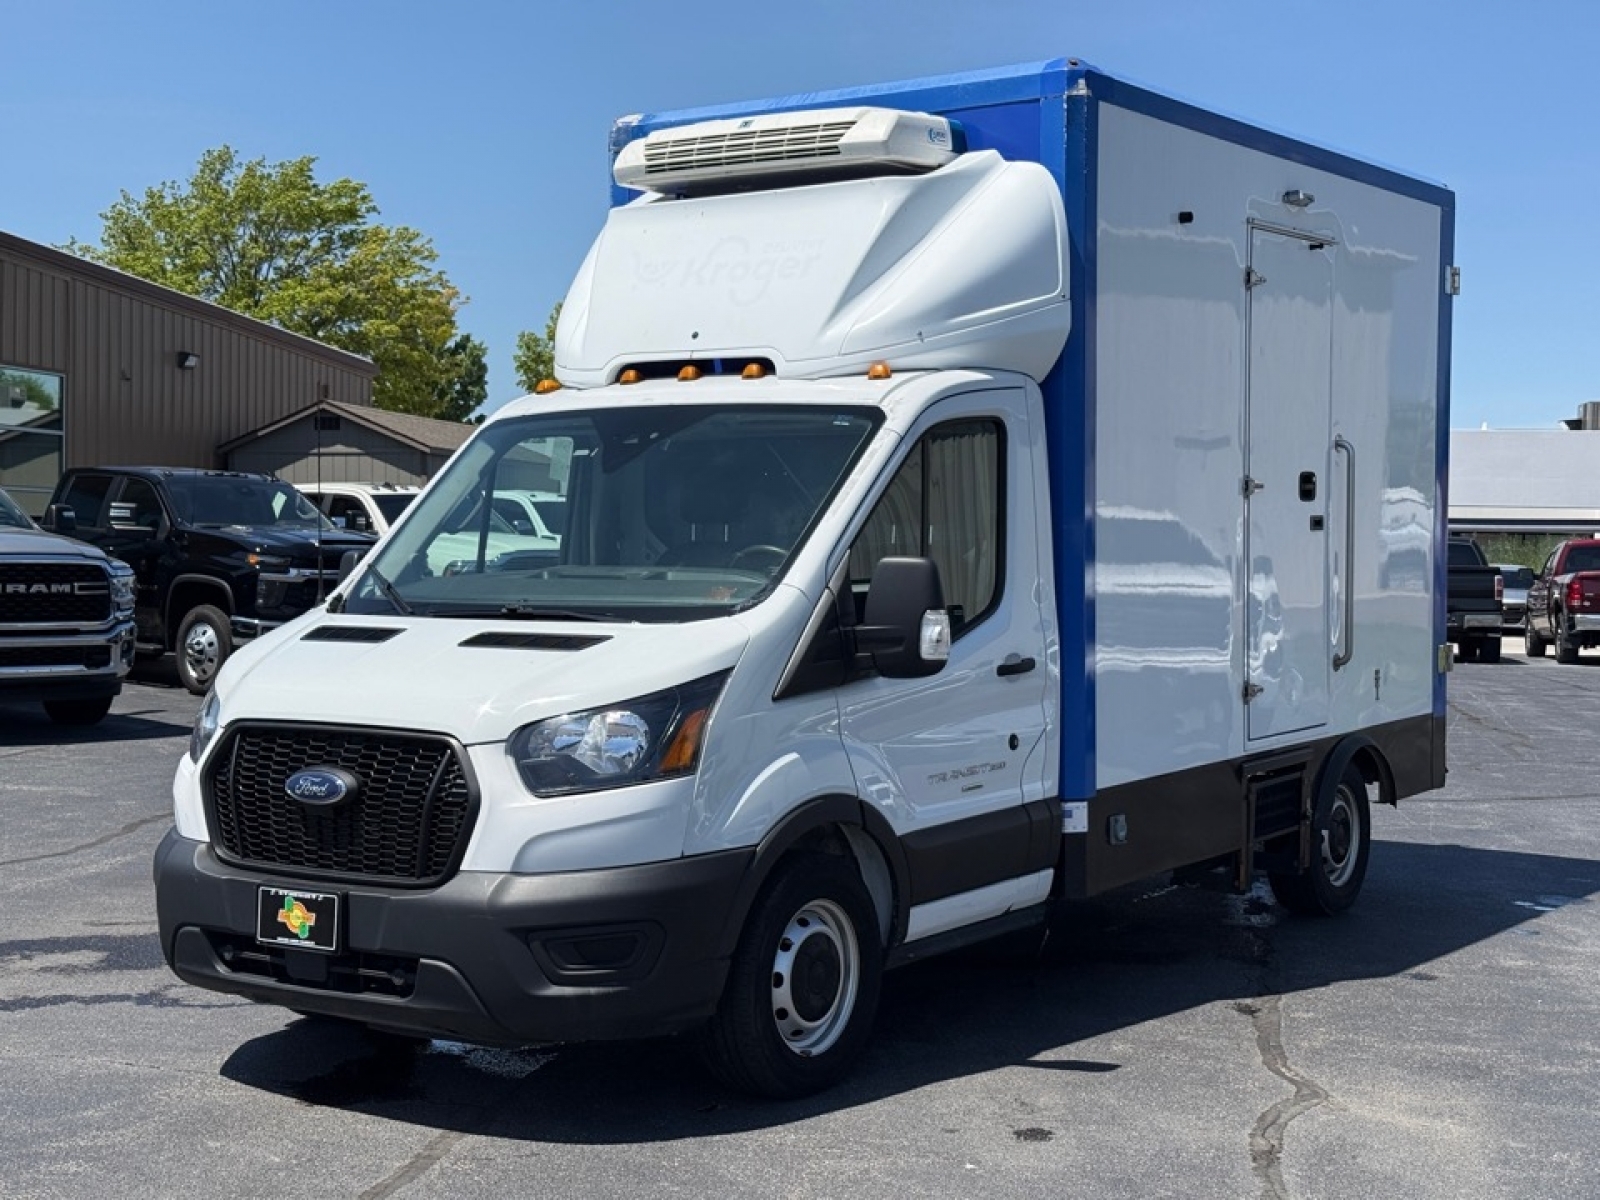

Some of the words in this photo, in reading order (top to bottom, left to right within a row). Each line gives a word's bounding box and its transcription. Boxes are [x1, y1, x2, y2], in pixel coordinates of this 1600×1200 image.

[680, 235, 821, 307] Kroger
[6, 583, 71, 593] RAM
[295, 776, 329, 795] Ford
